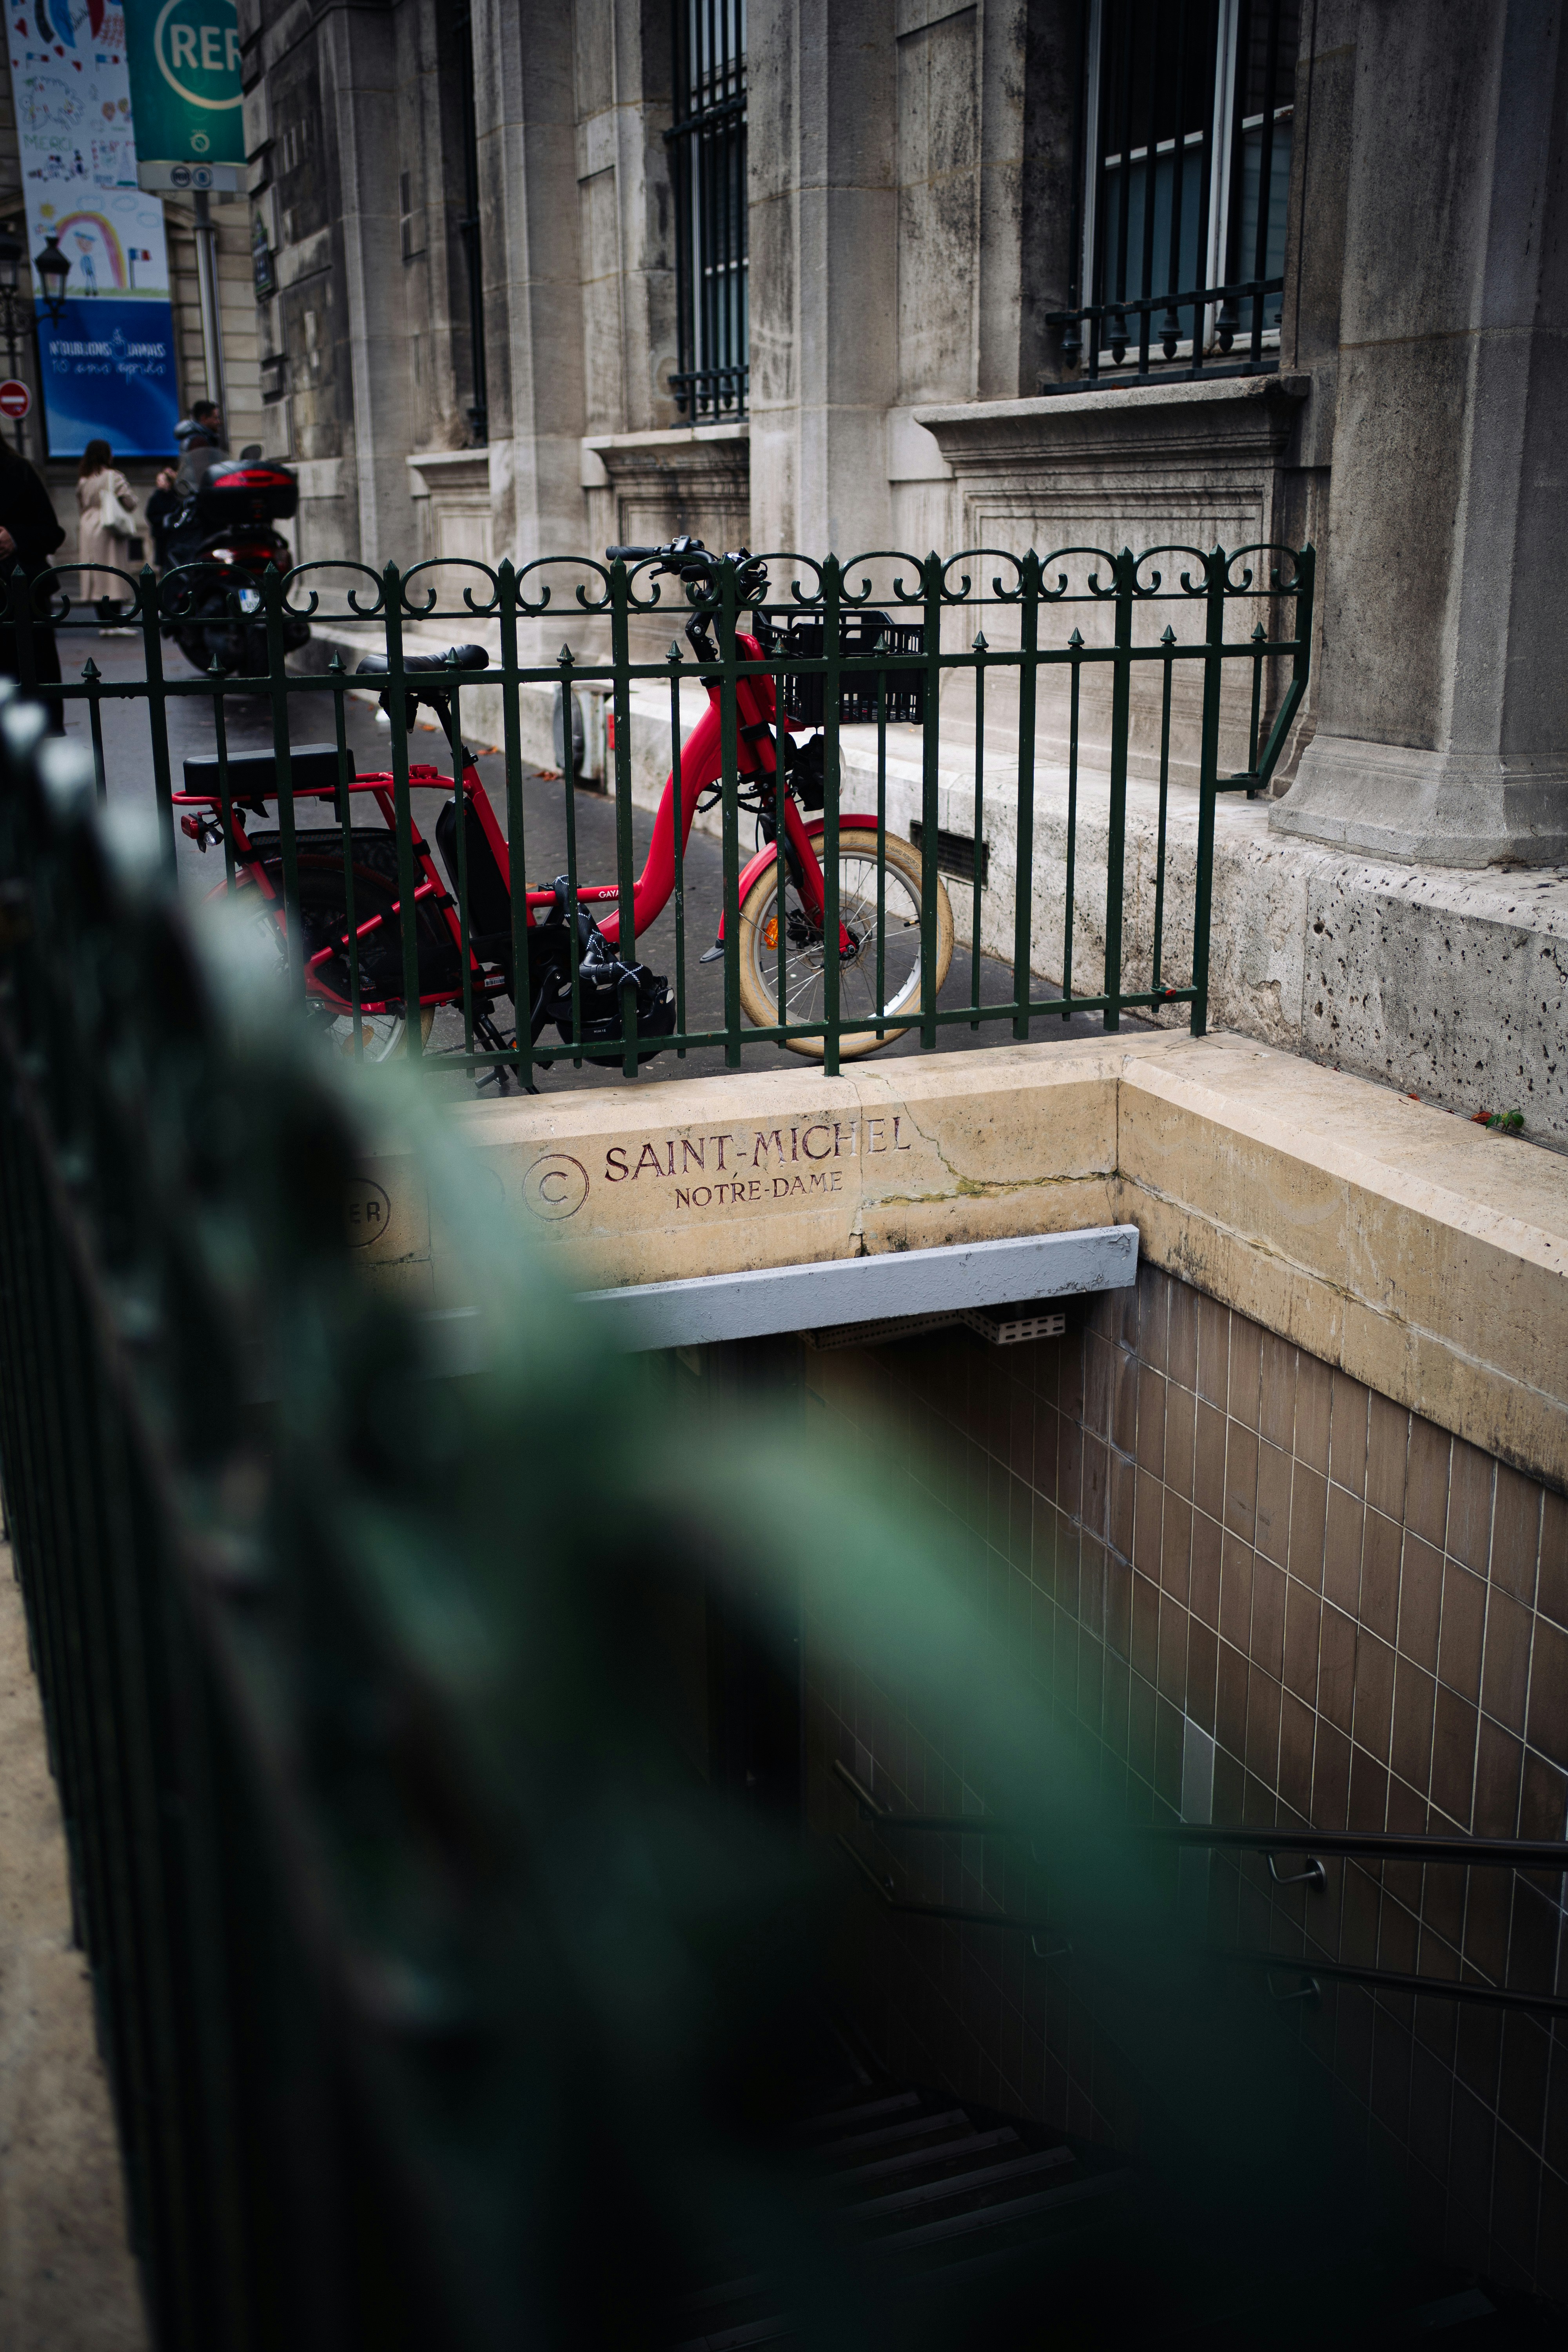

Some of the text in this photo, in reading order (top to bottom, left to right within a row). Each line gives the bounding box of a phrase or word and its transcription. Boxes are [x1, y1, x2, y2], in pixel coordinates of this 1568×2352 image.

[23, 134, 73, 151] MERCI
[49, 340, 166, 358] N'OUBLIONS JAMAIS
[74, 363, 112, 375] ans
[116, 357, 167, 385] après
[539, 1116, 911, 1206] C SAINT-MICHEL
[675, 1171, 843, 1210] NOTRE-DAME
[349, 1201, 381, 1224] ER
